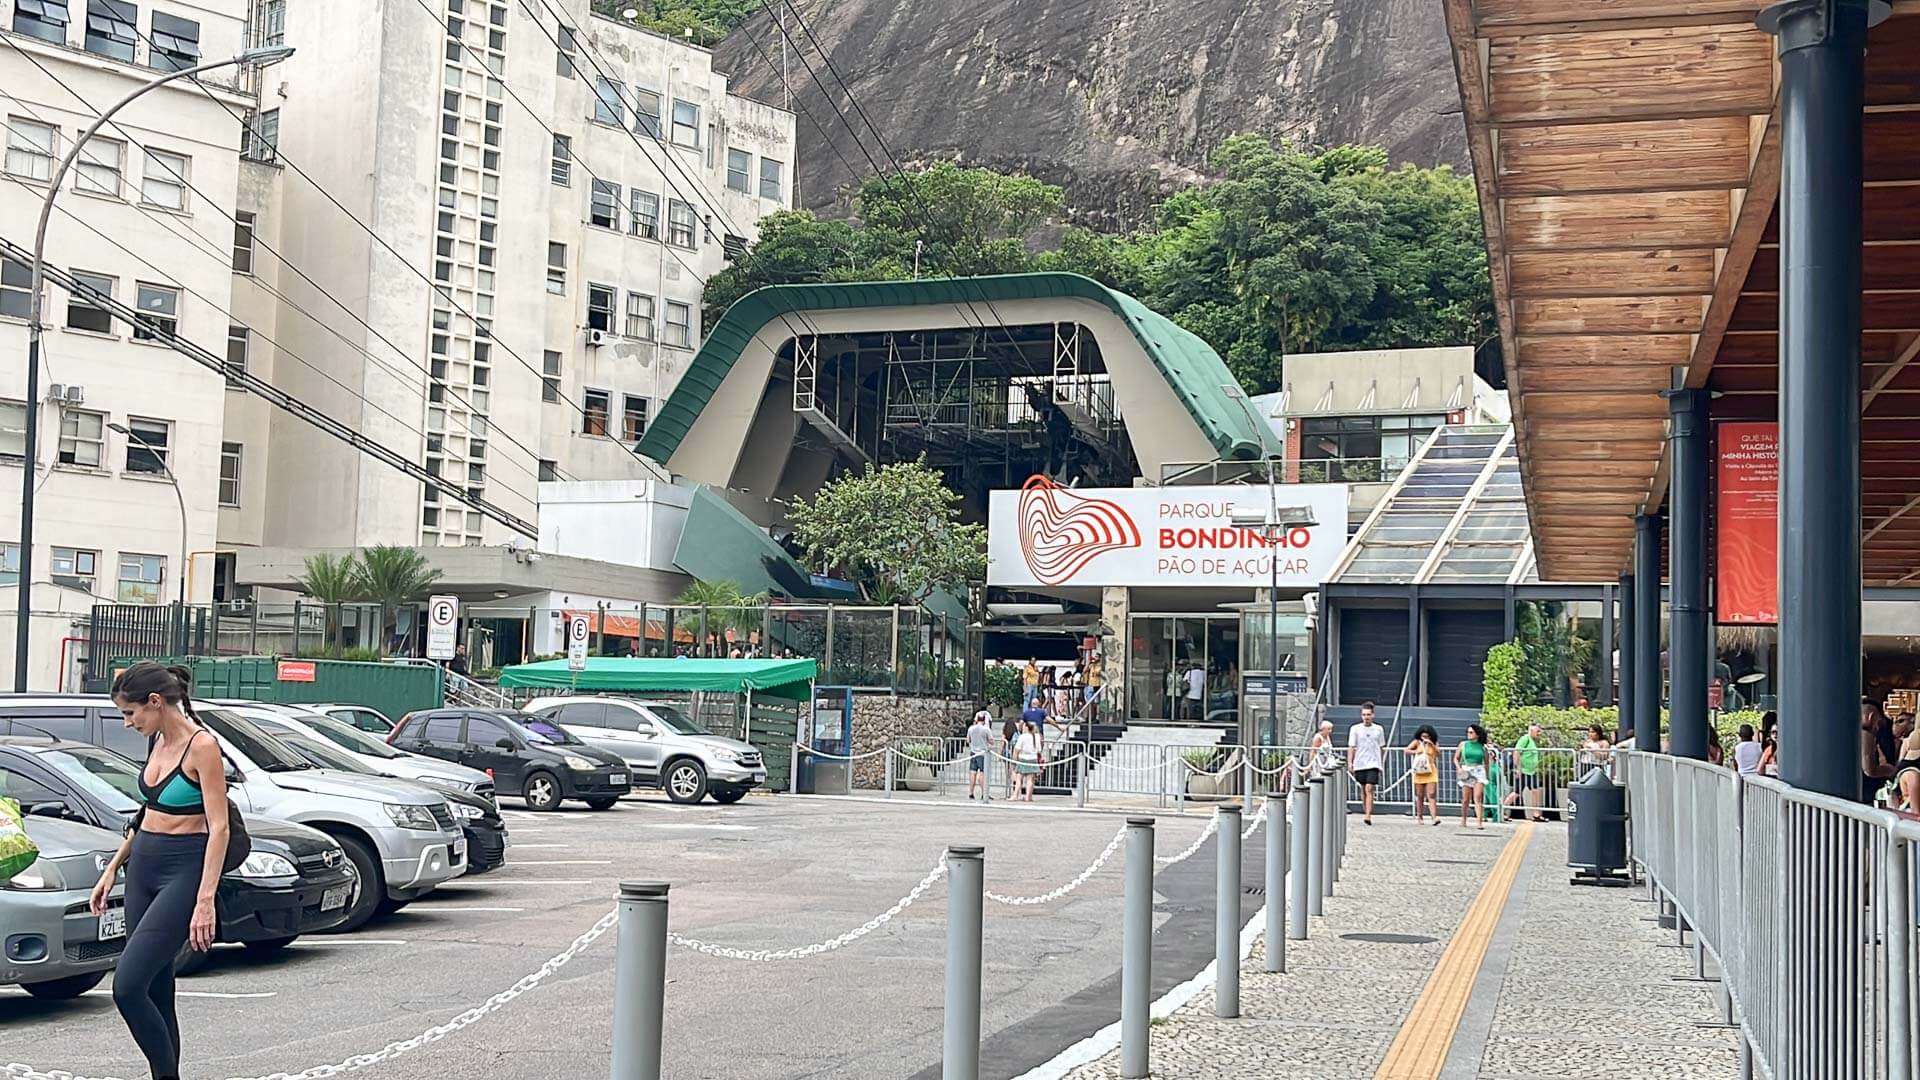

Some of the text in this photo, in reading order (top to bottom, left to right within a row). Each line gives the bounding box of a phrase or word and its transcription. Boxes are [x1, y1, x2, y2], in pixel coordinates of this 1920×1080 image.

[1740, 443, 1774, 451] VIAGEM
[1721, 451, 1778, 460] MINHA HISTÓ
[1159, 502, 1235, 519] PARQUE
[1158, 555, 1197, 575] PÃO
[1202, 559, 1226, 574] DE
[439, 606, 448, 620] E
[576, 623, 584, 637] E
